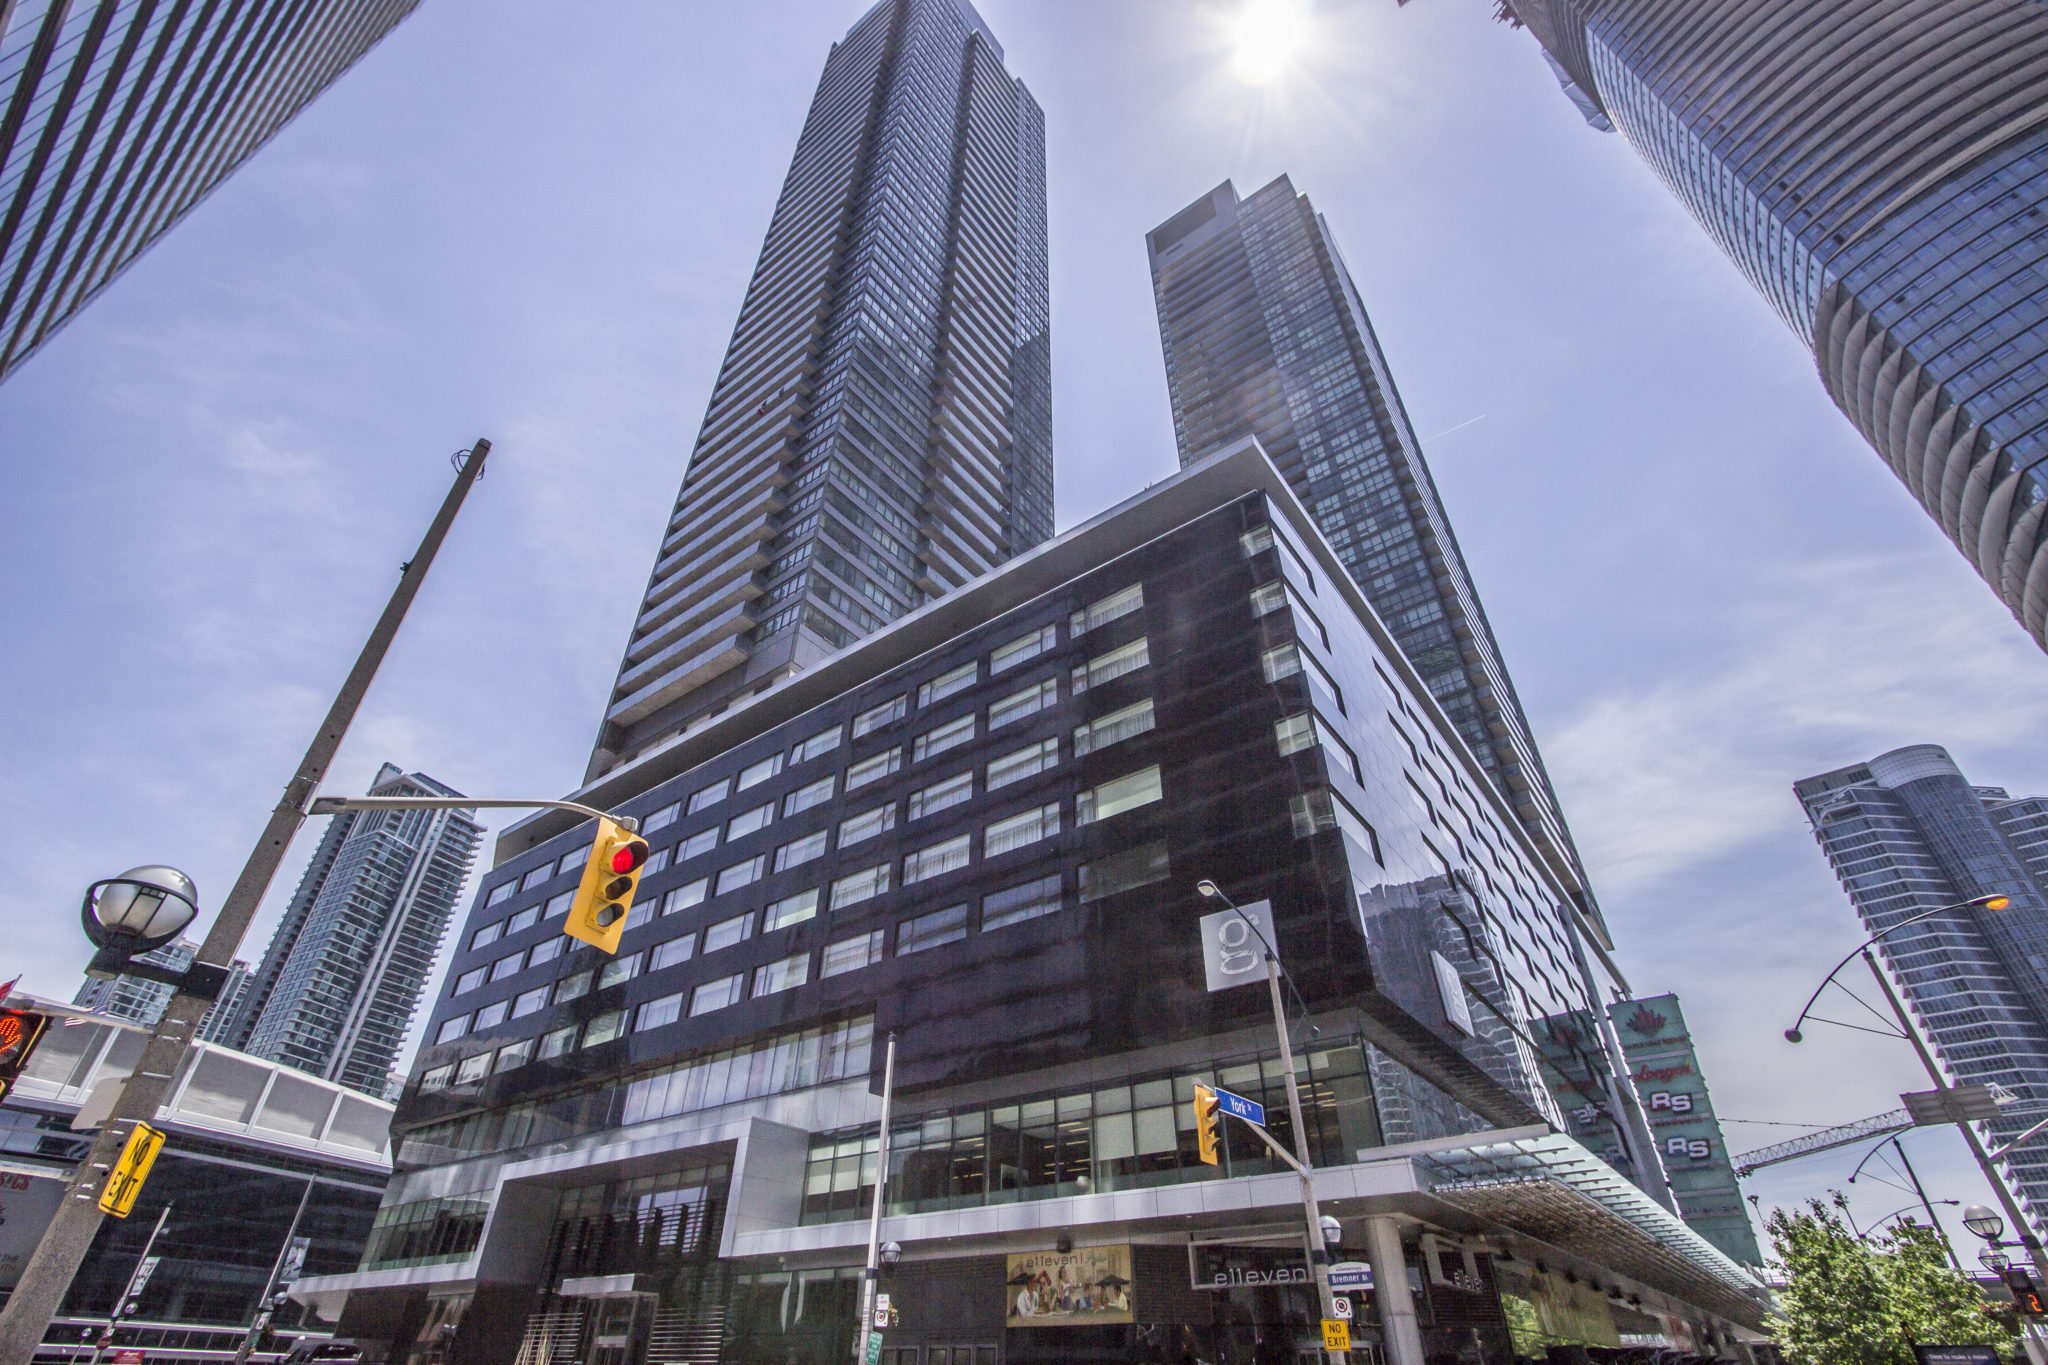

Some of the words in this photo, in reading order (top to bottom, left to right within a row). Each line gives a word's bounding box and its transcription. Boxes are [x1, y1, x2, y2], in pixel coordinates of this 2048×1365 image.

[1230, 1097, 1247, 1116] York
[1651, 1092, 1692, 1112] RS
[128, 1138, 151, 1166] NO
[1667, 1137, 1709, 1158] RS
[107, 1171, 138, 1204] EXIT
[1331, 1275, 1359, 1284] Bremner
[1328, 1324, 1341, 1333] NO
[1327, 1337, 1346, 1347] EXIT
